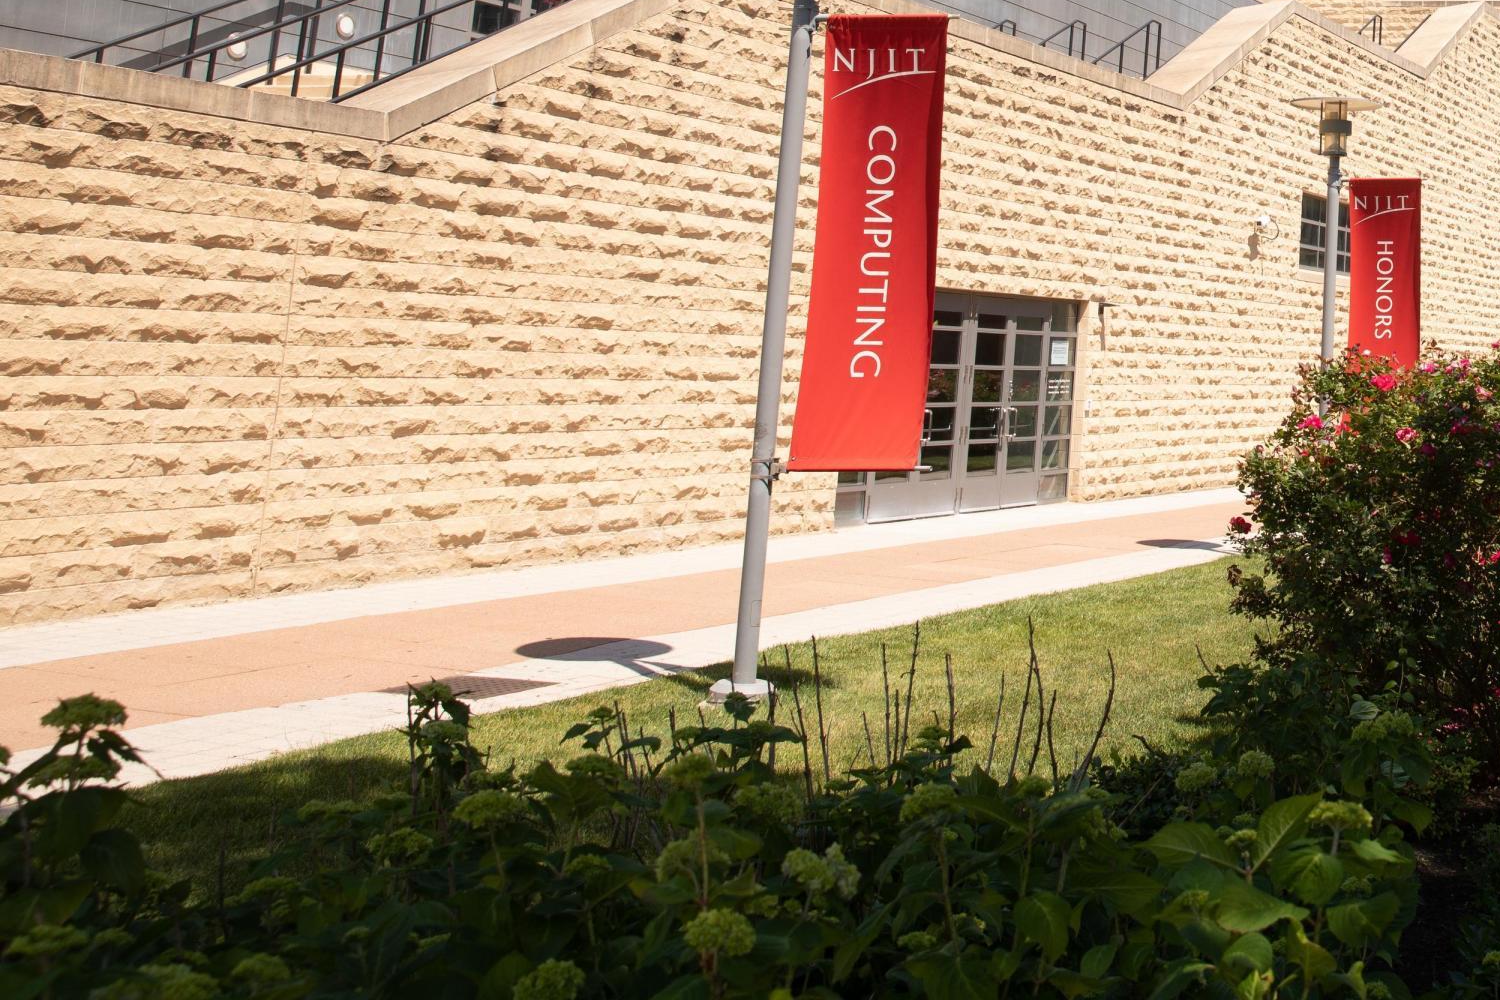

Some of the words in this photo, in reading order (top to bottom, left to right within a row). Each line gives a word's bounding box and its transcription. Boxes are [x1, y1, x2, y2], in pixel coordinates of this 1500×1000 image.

[833, 47, 926, 79] NJIT
[1353, 195, 1410, 212] NJIT
[850, 124, 897, 379] COMPUTING
[1374, 240, 1395, 340] HONORS
